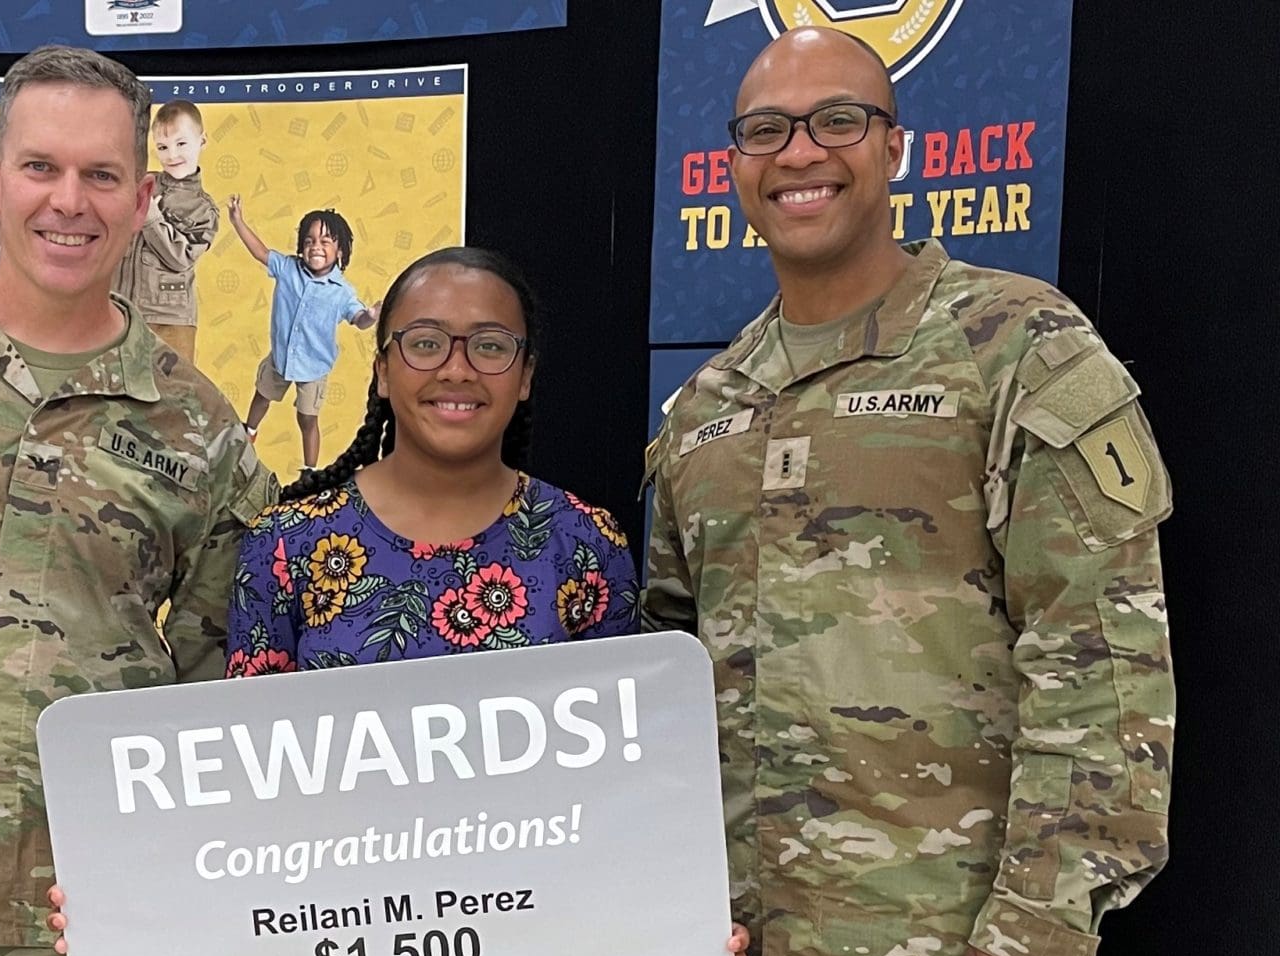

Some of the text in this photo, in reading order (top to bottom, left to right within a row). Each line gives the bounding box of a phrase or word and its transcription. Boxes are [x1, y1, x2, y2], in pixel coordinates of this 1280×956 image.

[173, 85, 226, 94] 2210
[245, 80, 353, 94] TROOPER
[371, 75, 441, 90] DRIVE
[922, 121, 1037, 179] BACK
[680, 205, 732, 251] TO
[926, 183, 1032, 238] YEAR
[695, 418, 734, 446] PEREZ
[142, 450, 189, 483] ARMY
[111, 677, 643, 815] REWARDS!
[195, 803, 583, 884] Congratulations!
[252, 889, 535, 937] Reilani M. Perez
